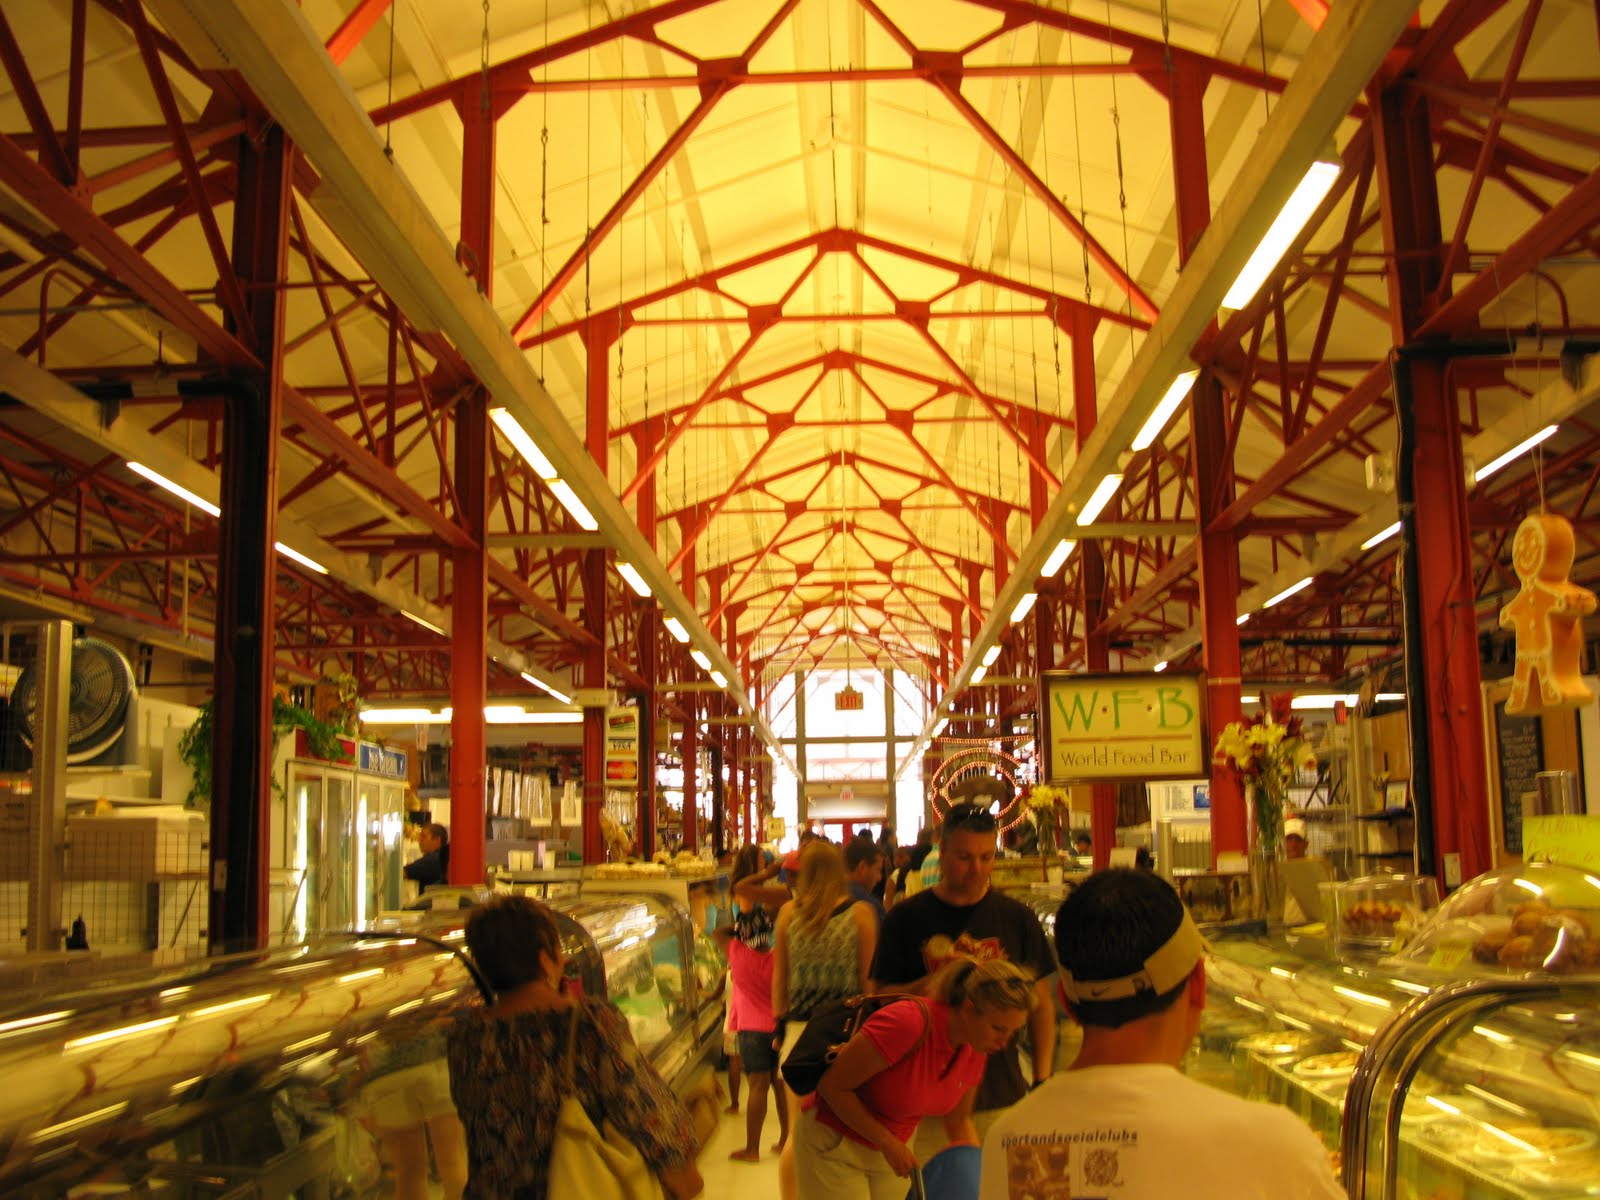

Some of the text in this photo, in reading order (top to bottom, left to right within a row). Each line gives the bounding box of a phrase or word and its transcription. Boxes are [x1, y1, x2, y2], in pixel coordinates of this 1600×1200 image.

[1061, 745, 1188, 767] World Food Bar
